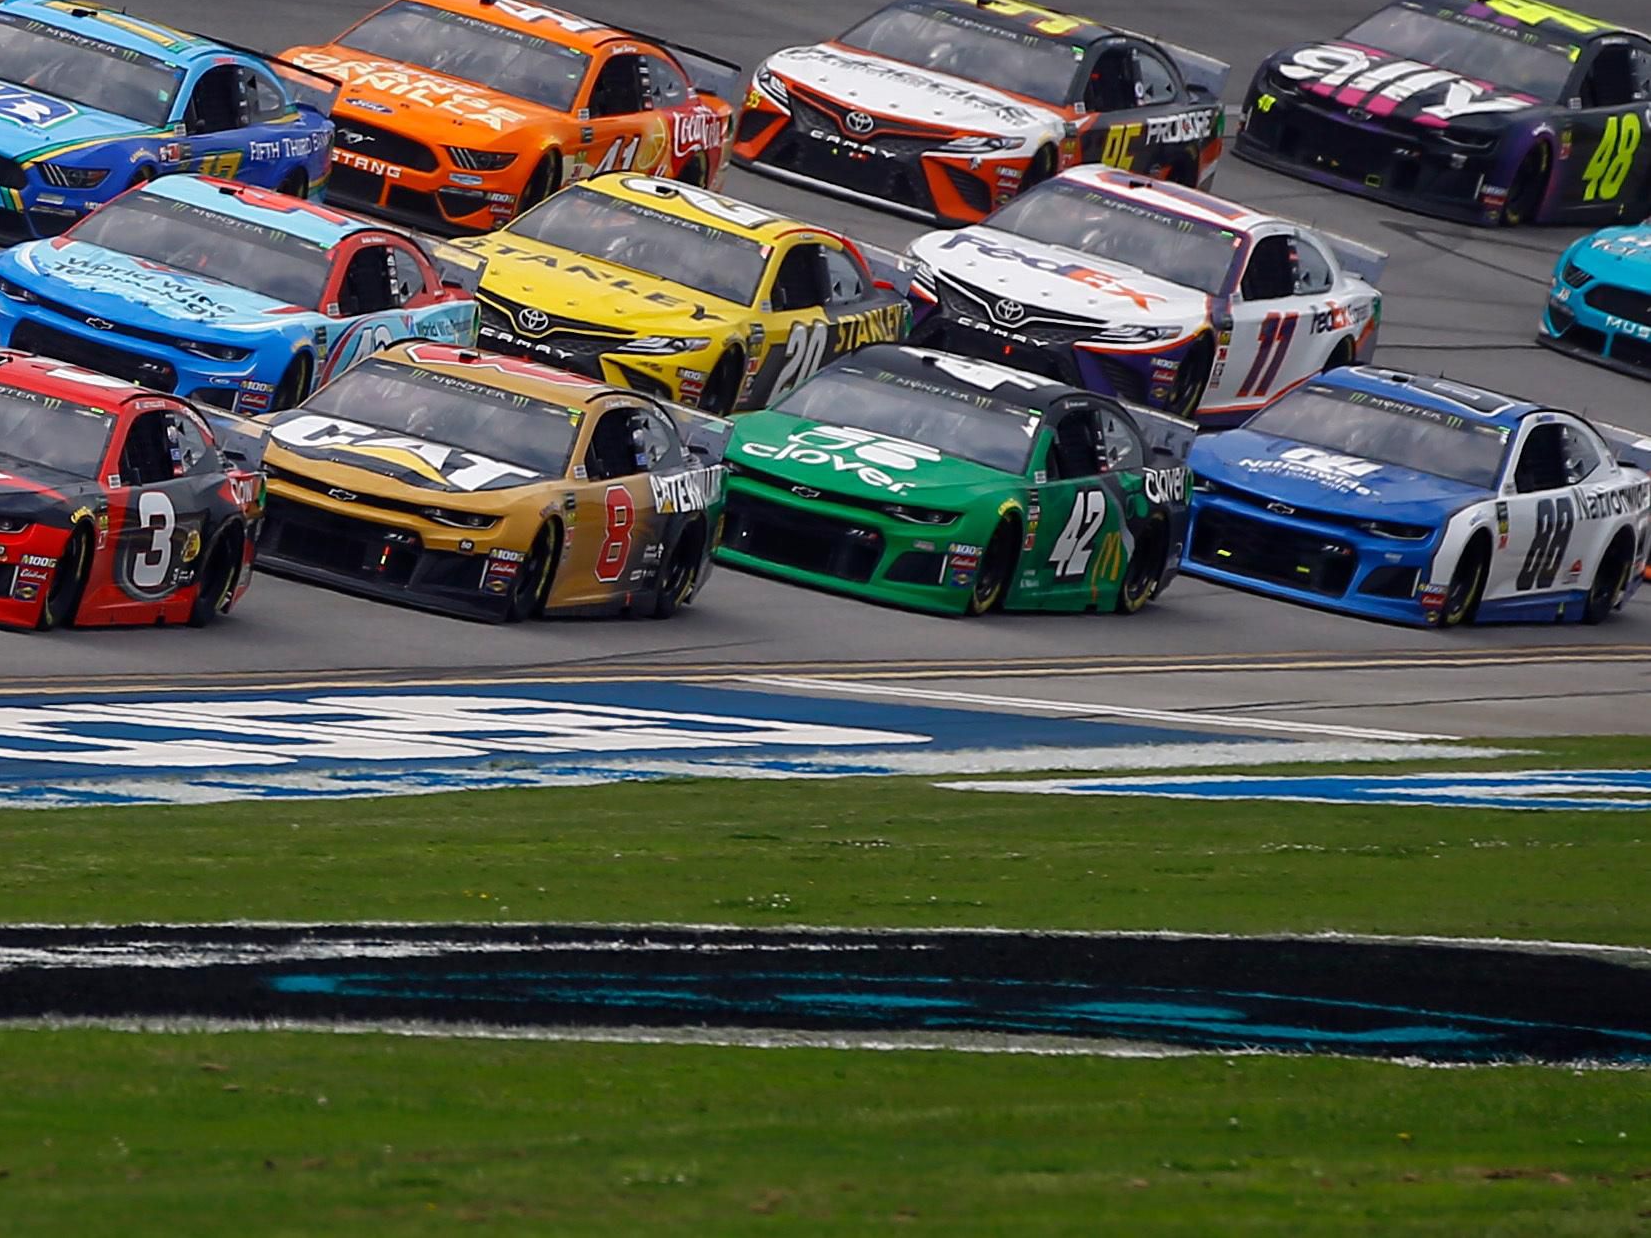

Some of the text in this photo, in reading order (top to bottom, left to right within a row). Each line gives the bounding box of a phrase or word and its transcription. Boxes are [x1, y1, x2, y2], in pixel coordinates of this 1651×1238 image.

[331, 150, 402, 179] STANG
[810, 129, 897, 159] CAMRY
[1582, 112, 1642, 202] 48
[480, 326, 575, 360] CAMRY
[767, 320, 828, 404] 20
[957, 317, 1049, 347] CAMRY
[1236, 311, 1300, 398] 11
[270, 414, 541, 492] CAT
[741, 442, 917, 496] clover
[132, 491, 176, 588] 3
[594, 483, 636, 583] 8
[1049, 490, 1107, 578] 42
[1515, 496, 1575, 592] 88
